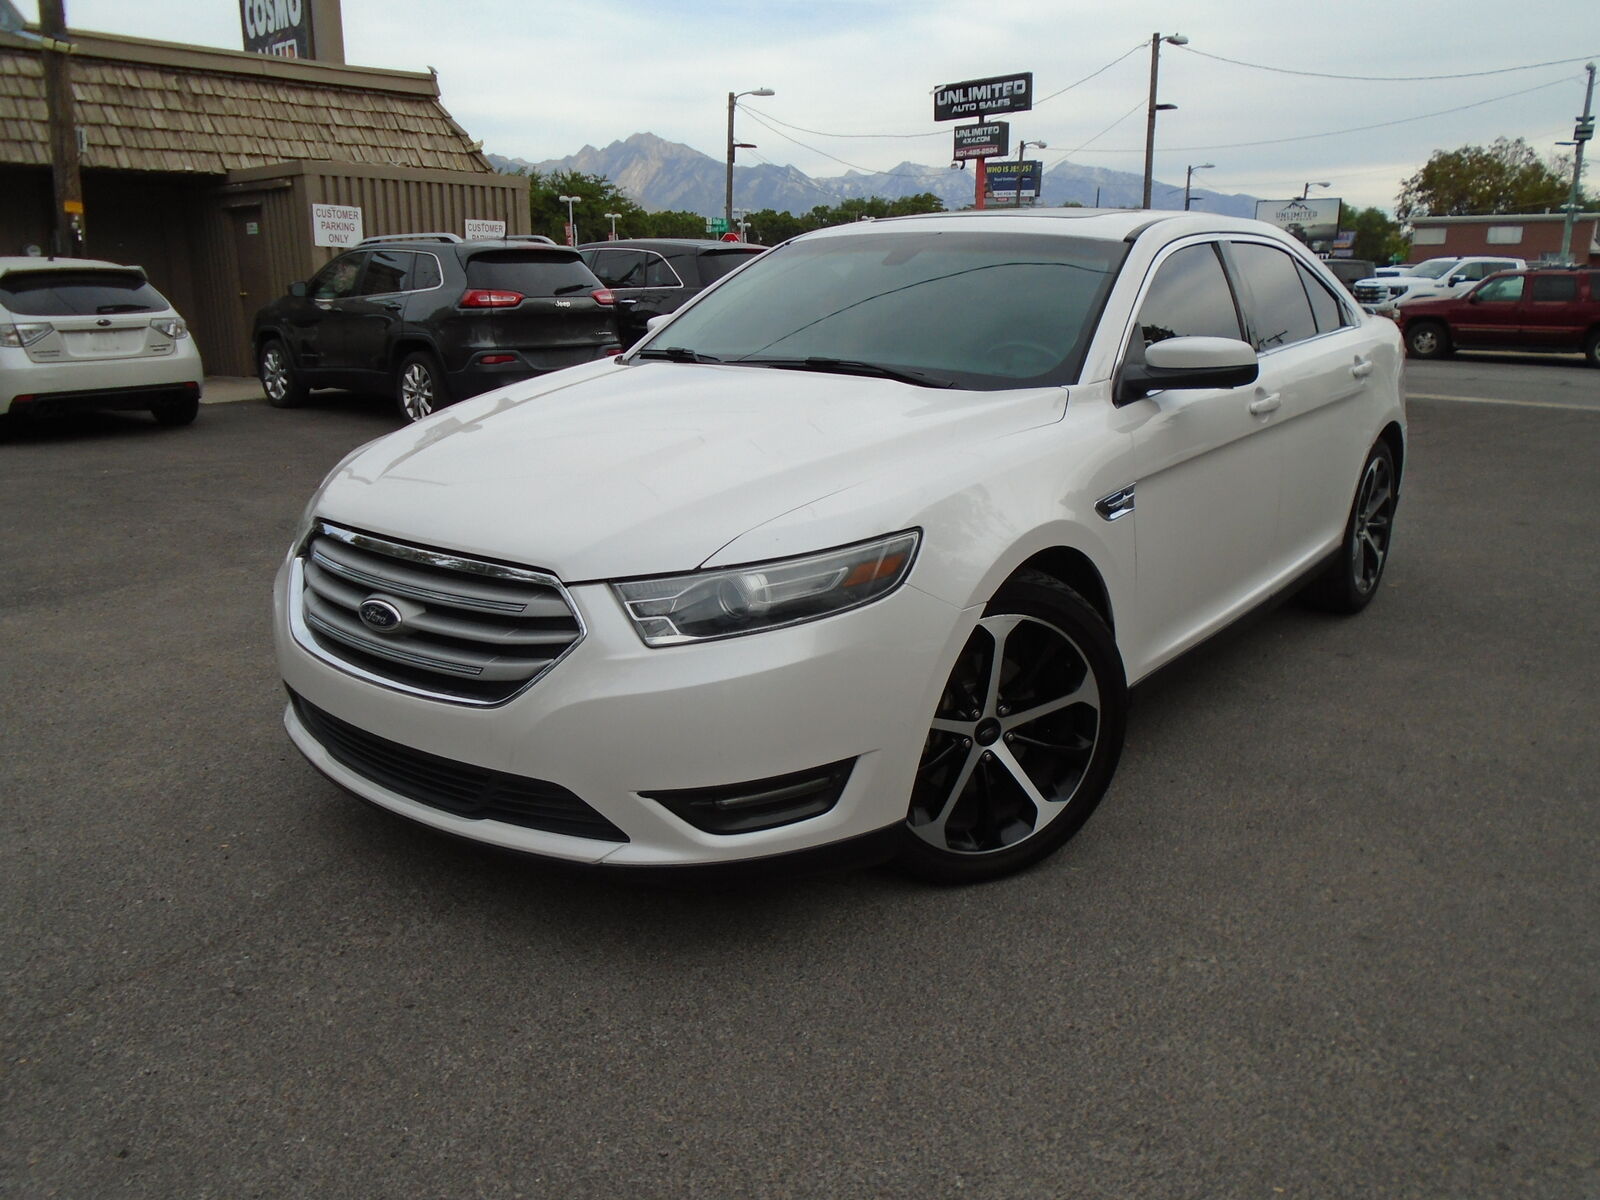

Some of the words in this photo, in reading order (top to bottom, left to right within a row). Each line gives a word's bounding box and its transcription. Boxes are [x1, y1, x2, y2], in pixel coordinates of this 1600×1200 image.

[936, 79, 1026, 106] UNLIMITED
[951, 102, 977, 114] AUTO
[978, 98, 1011, 110] SALES
[955, 126, 1000, 138] UNLIMITED
[315, 208, 359, 220] CUSTOMER
[320, 221, 356, 232] PARKING
[467, 223, 504, 233] CUSTOMER
[328, 233, 350, 243] ONLY
